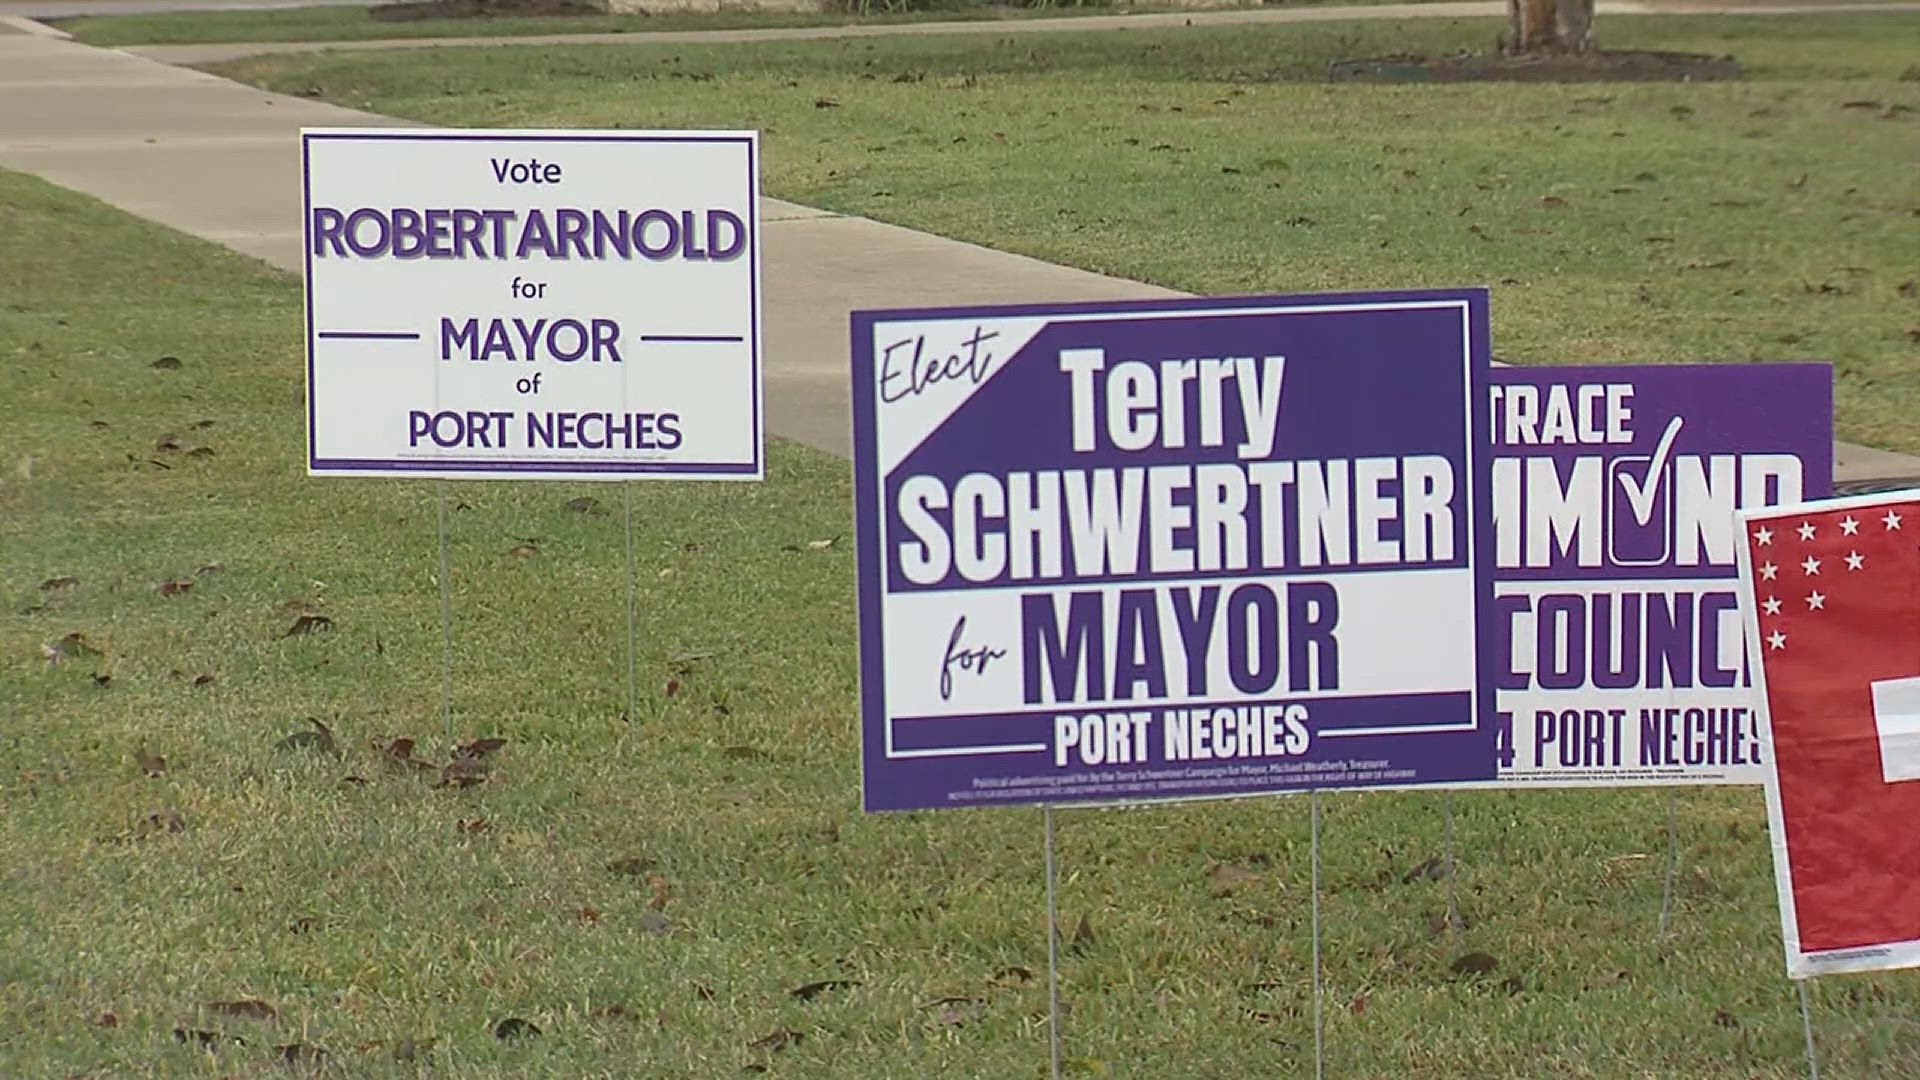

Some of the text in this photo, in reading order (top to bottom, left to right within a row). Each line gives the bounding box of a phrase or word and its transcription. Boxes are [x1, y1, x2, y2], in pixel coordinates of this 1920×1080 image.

[491, 157, 561, 183] Vote
[313, 207, 746, 261] ROBERT ARNOLD
[511, 276, 547, 299] for
[441, 318, 621, 362] MAYOR
[880, 326, 1000, 403] Elect
[516, 372, 541, 394] of
[1060, 347, 1286, 459] Terry
[409, 411, 682, 450] PORT NECHES
[899, 454, 1456, 584] SCHWERTNER
[939, 580, 1341, 705] for MAYOR
[1497, 591, 1752, 690] COUNC
[1055, 704, 1310, 767] PORT NECHES
[1534, 709, 1627, 767] PORT
